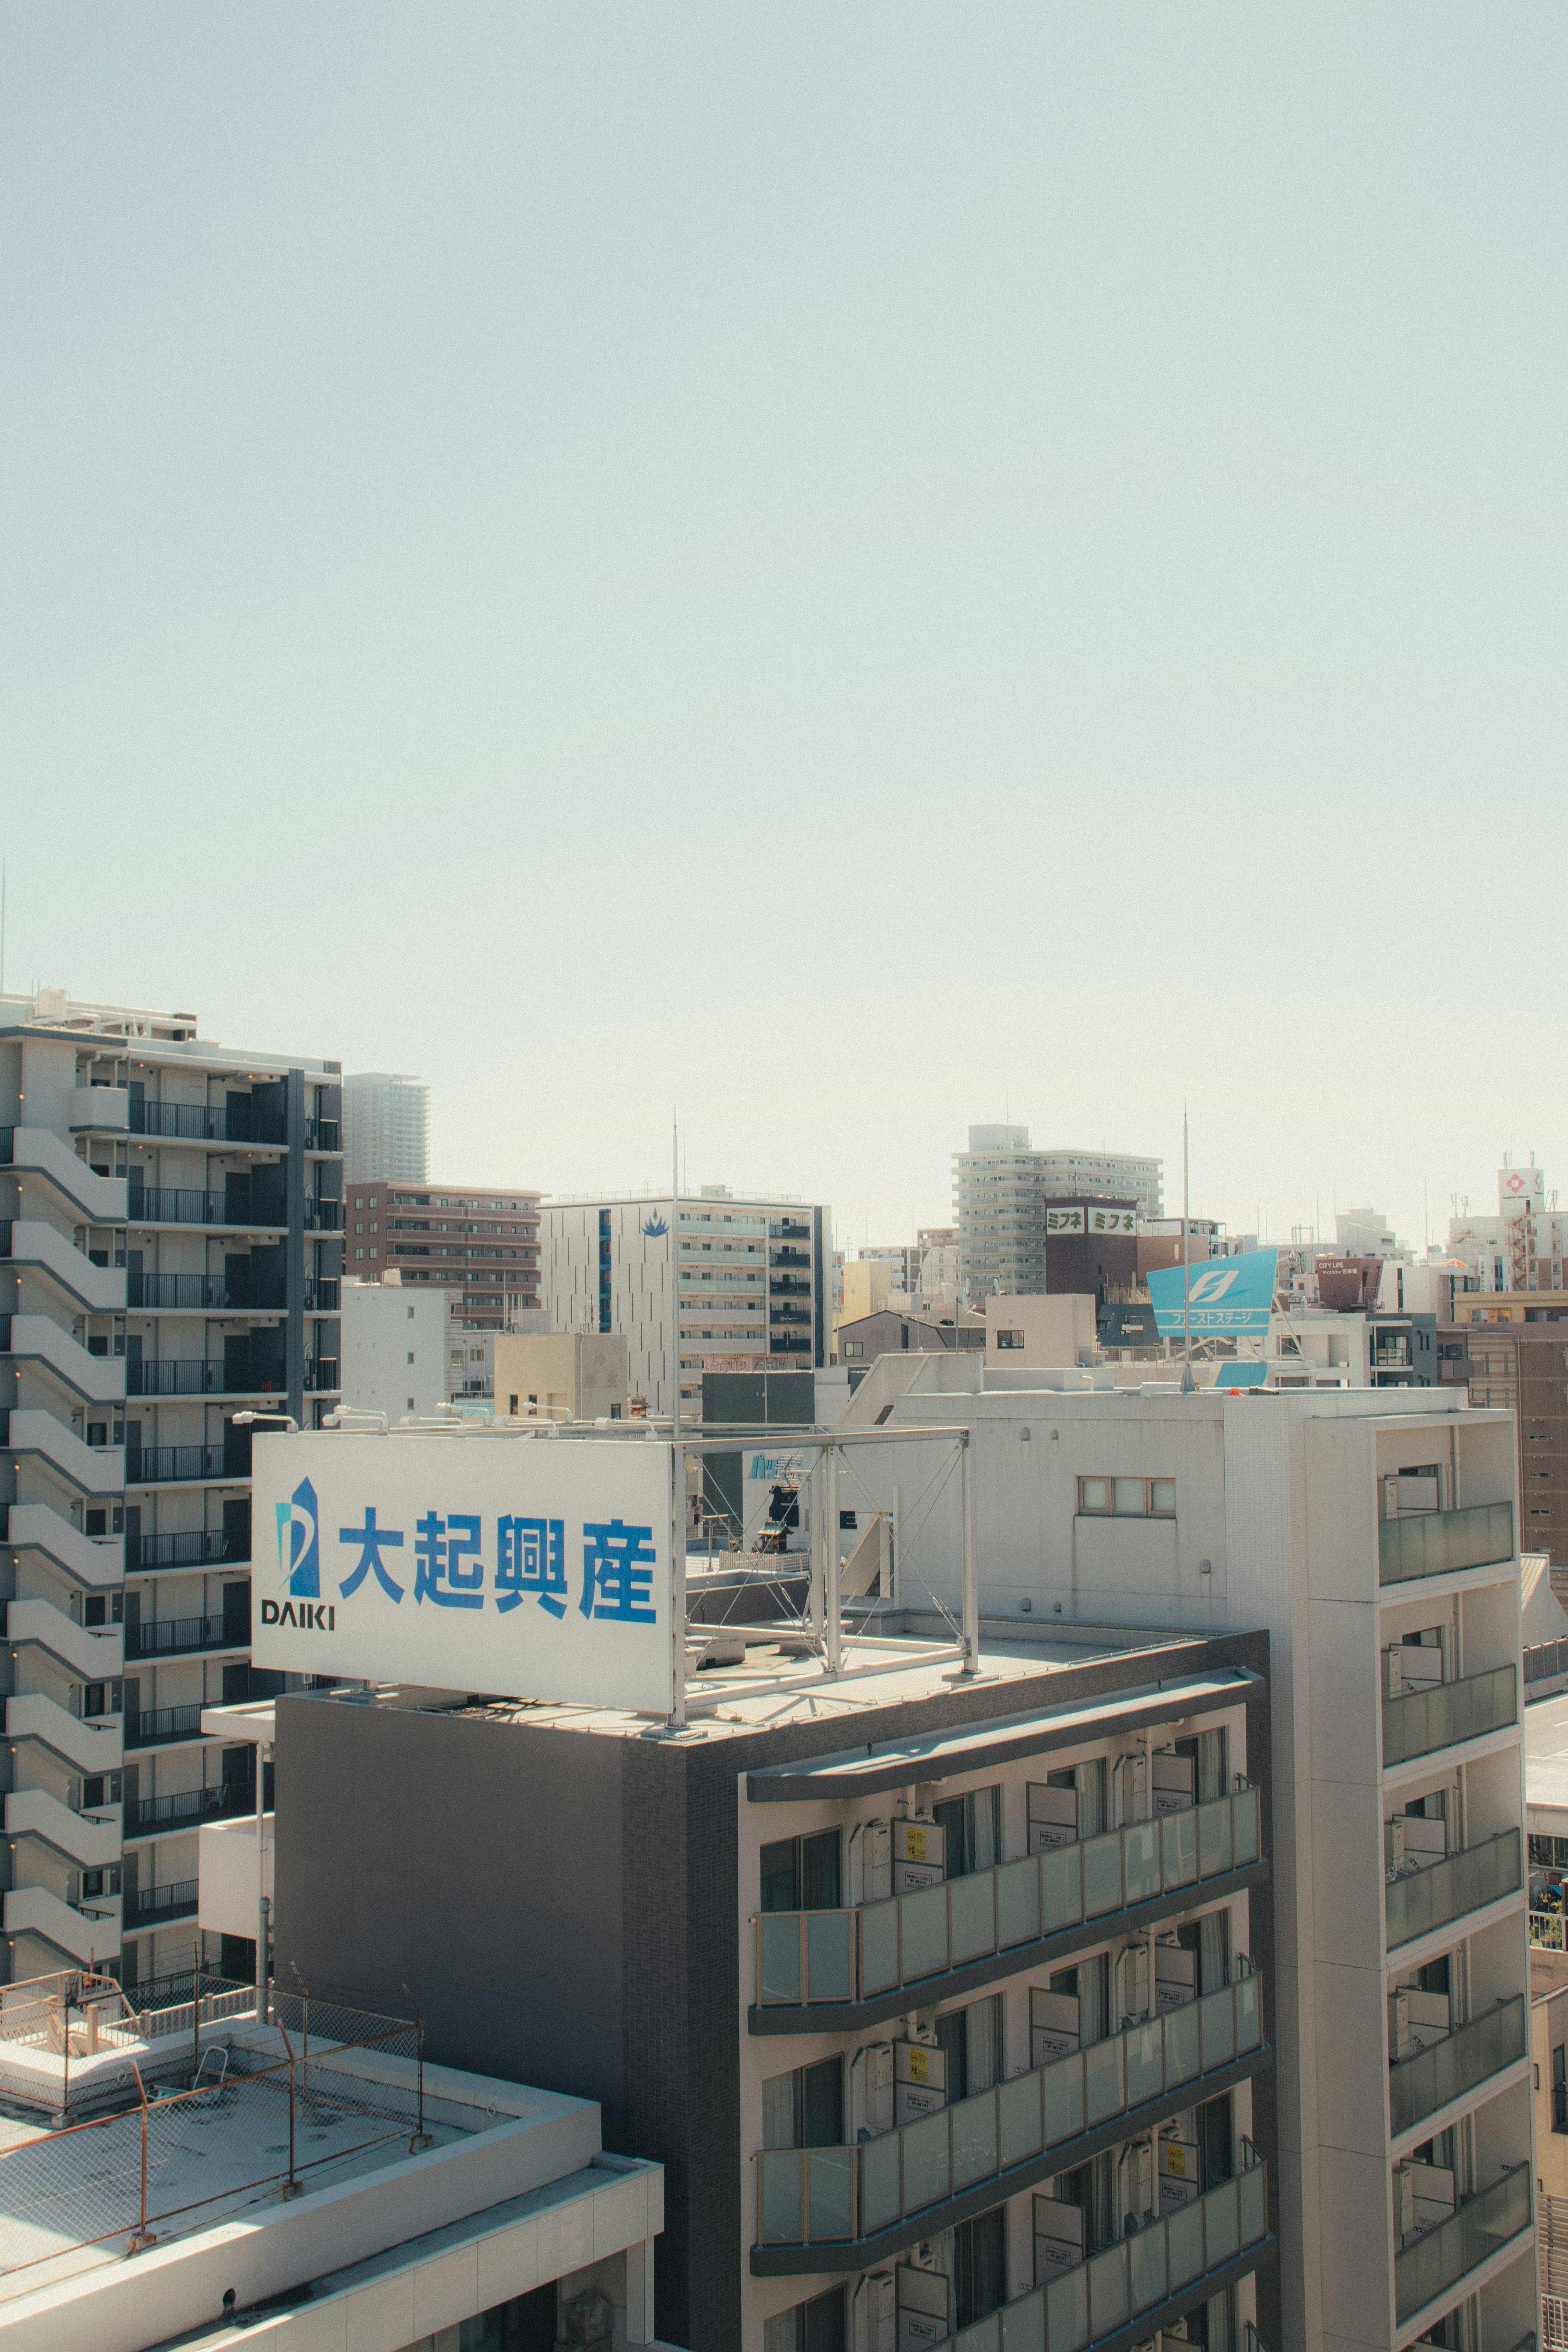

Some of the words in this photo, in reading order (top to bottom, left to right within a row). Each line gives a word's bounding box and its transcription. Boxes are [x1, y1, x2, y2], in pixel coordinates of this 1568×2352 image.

[1047, 1212, 1081, 1230] ミフネ
[1095, 1212, 1133, 1230] ミフネ
[338, 1506, 656, 1624] 大起興産
[261, 1599, 335, 1631] DAIKI
